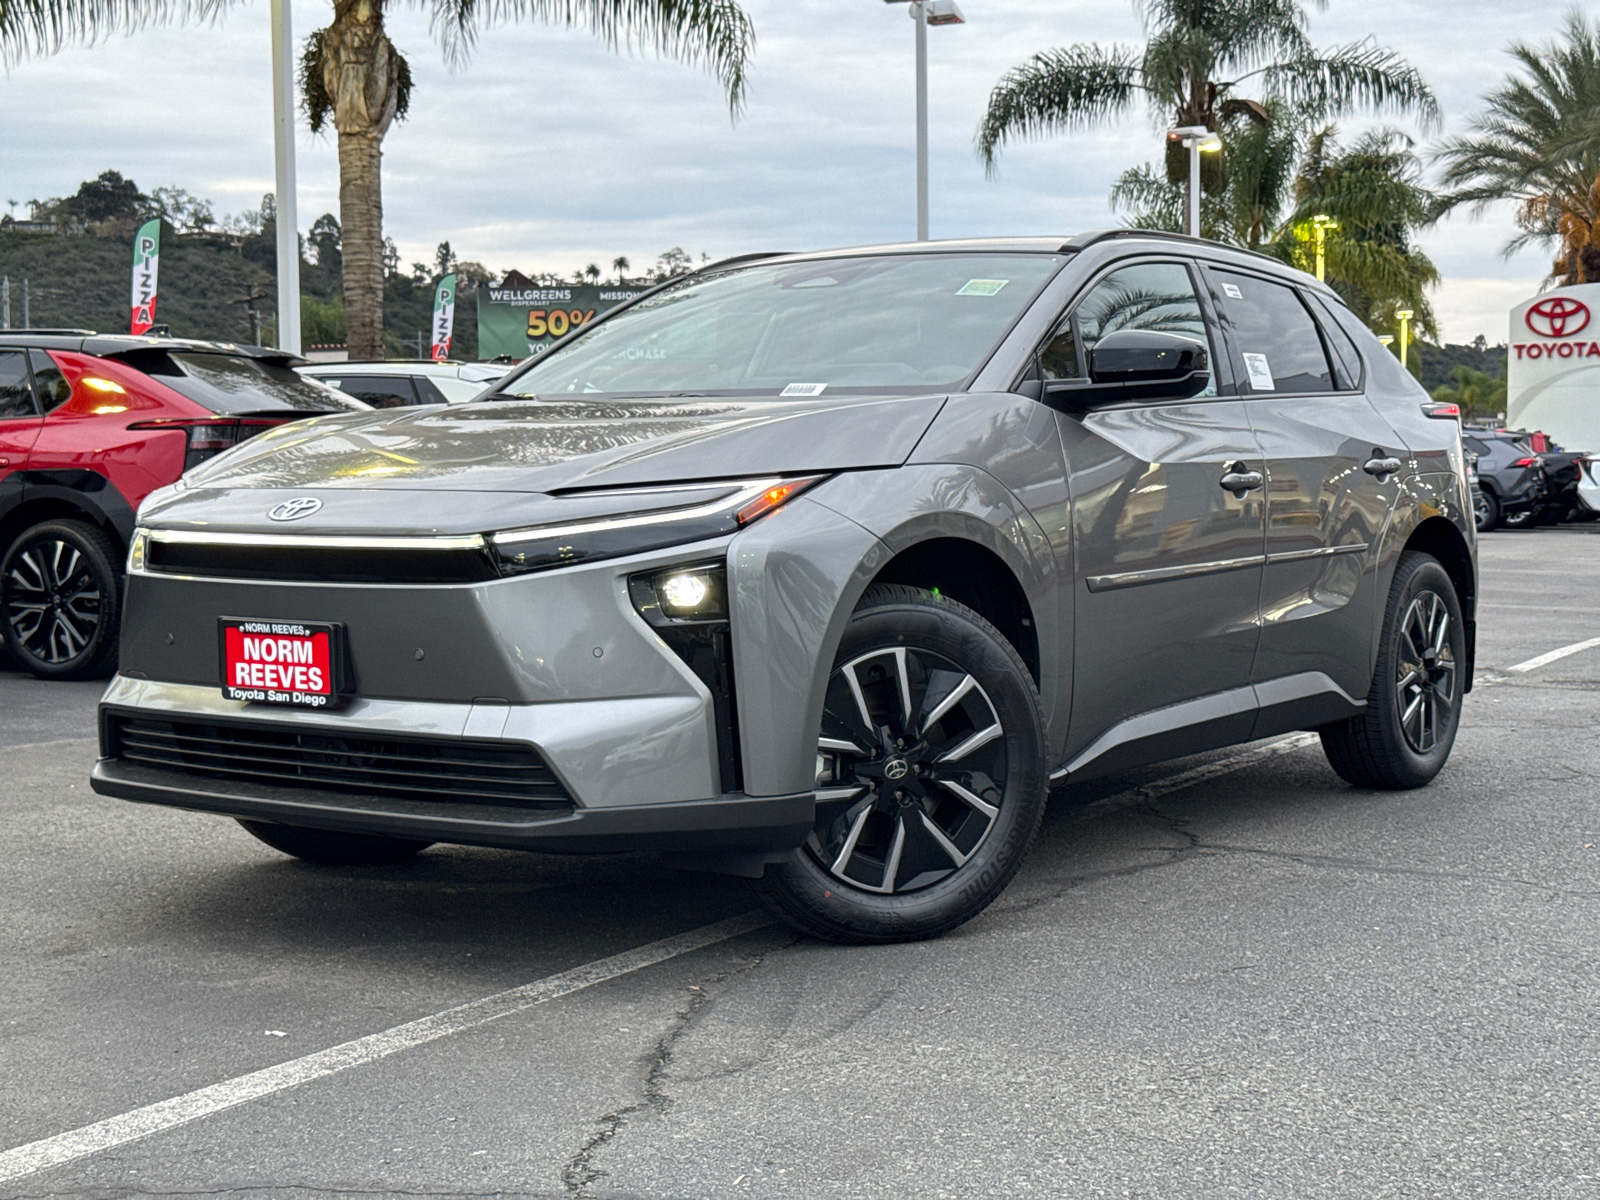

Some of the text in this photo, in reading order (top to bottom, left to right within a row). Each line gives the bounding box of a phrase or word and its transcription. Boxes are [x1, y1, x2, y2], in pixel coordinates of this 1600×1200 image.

[137, 238, 155, 324] PIZZA
[490, 290, 572, 301] WELLGREENS
[437, 289, 451, 358] PIZZA
[1513, 342, 1600, 360] TOYOTA
[244, 622, 304, 635] NORM REEVES
[243, 637, 313, 664] NORM
[235, 662, 324, 691] REEVES
[228, 687, 327, 706] Toyota San Diego
